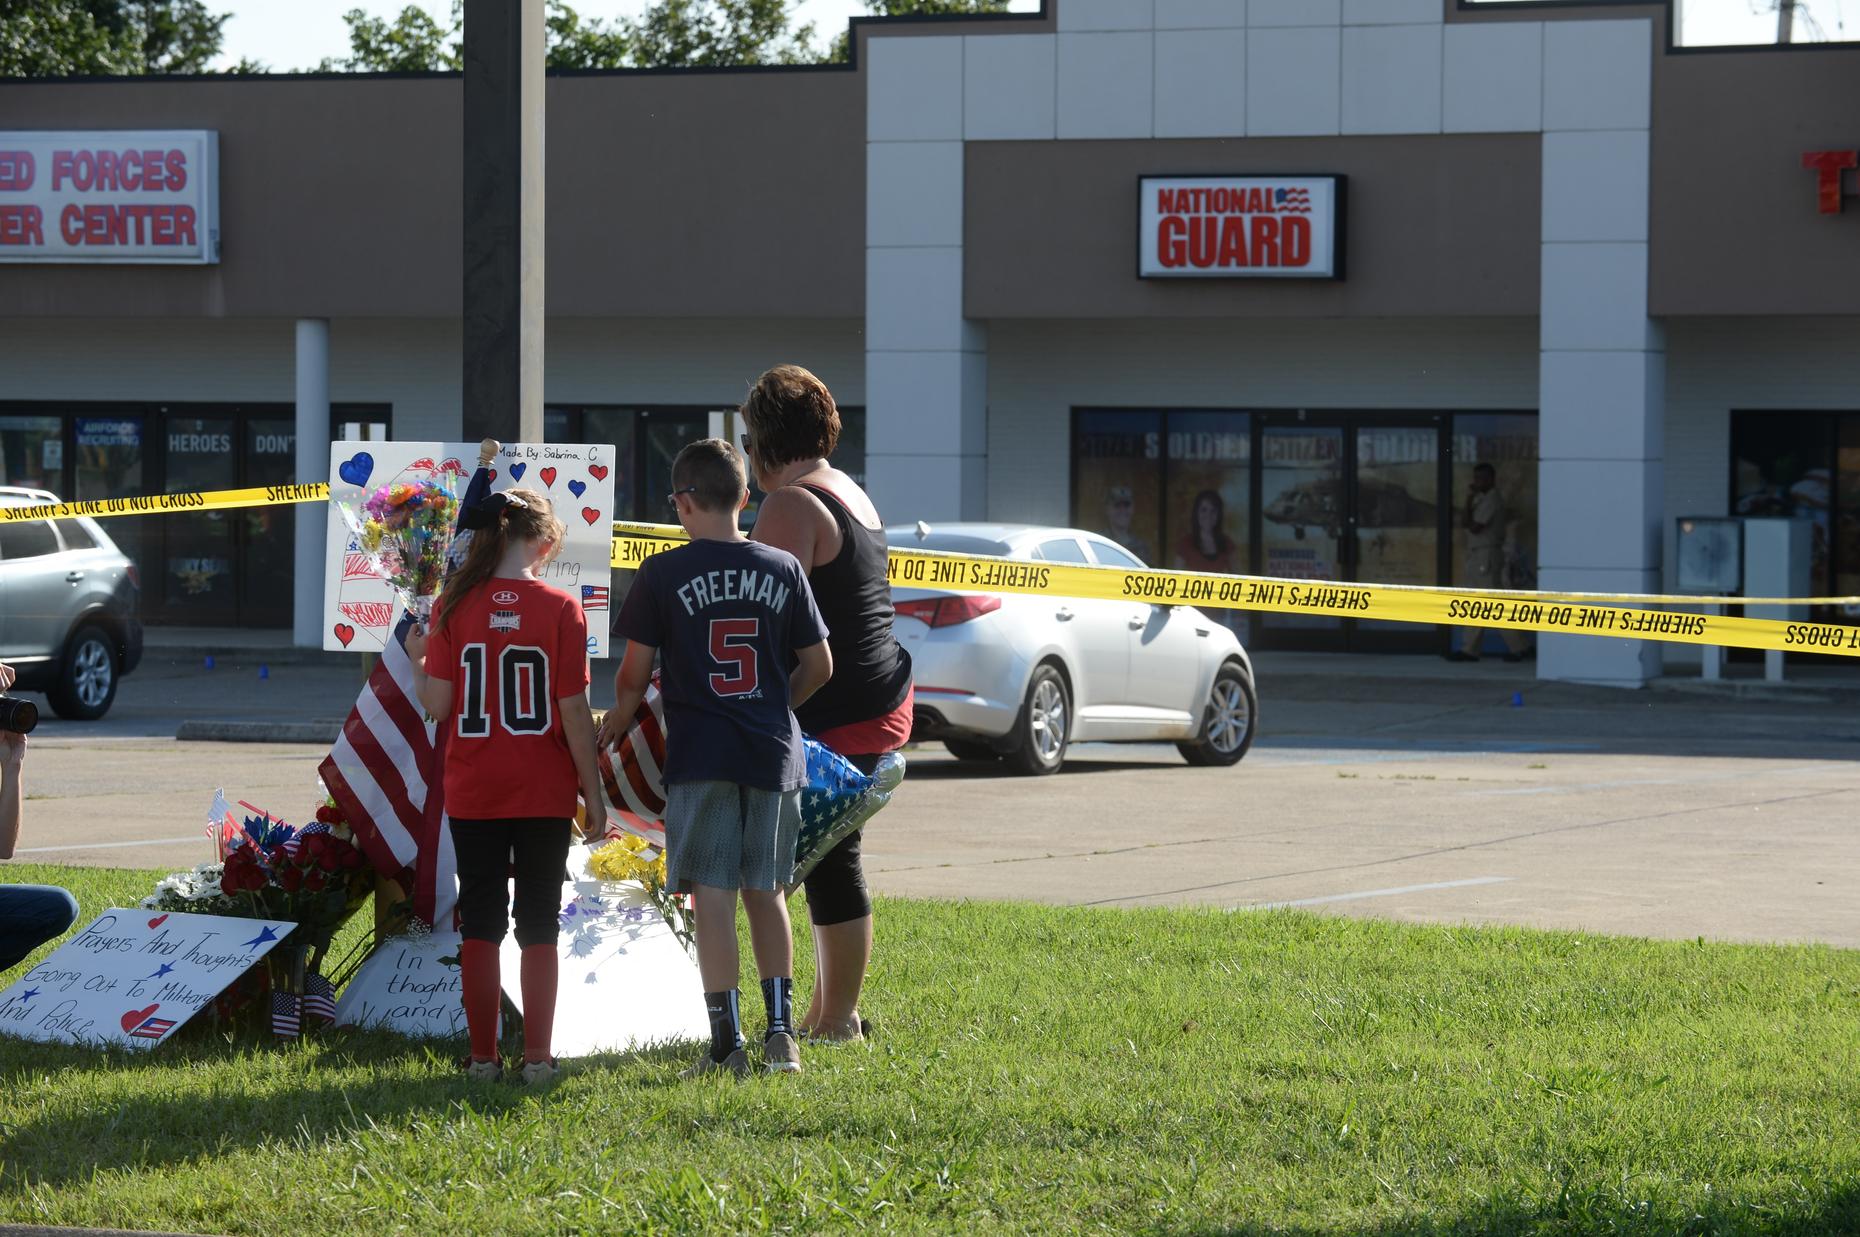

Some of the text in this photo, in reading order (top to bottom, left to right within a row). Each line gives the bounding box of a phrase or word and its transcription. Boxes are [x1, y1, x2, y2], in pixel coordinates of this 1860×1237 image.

[52, 149, 187, 192] FORCES
[1802, 150, 1860, 214] T
[1158, 188, 1276, 214] NATIONAL
[60, 203, 196, 246] CENTER
[1158, 215, 1311, 268] GUARD
[168, 434, 231, 452] HEROES
[527, 447, 541, 460] By:
[74, 502, 103, 515] LINE
[904, 559, 925, 581] DO
[930, 560, 966, 584] LINE
[972, 564, 1050, 588] SHERIFF'S
[676, 569, 791, 616] FREEMAN
[1122, 575, 1371, 610] SHERIFF'S LINE DO NOT CROSS
[1447, 599, 1706, 636] SHERIFF'S LINE DO NOT CROSS
[1784, 625, 1844, 647] CROSS
[708, 618, 759, 697] 5
[458, 643, 552, 737] 10
[72, 916, 255, 973] Prayers And Thoughts
[396, 949, 422, 969] In
[23, 962, 217, 1011] Going Out To Military
[386, 973, 463, 1004] thoght
[36, 1000, 95, 1034] Police
